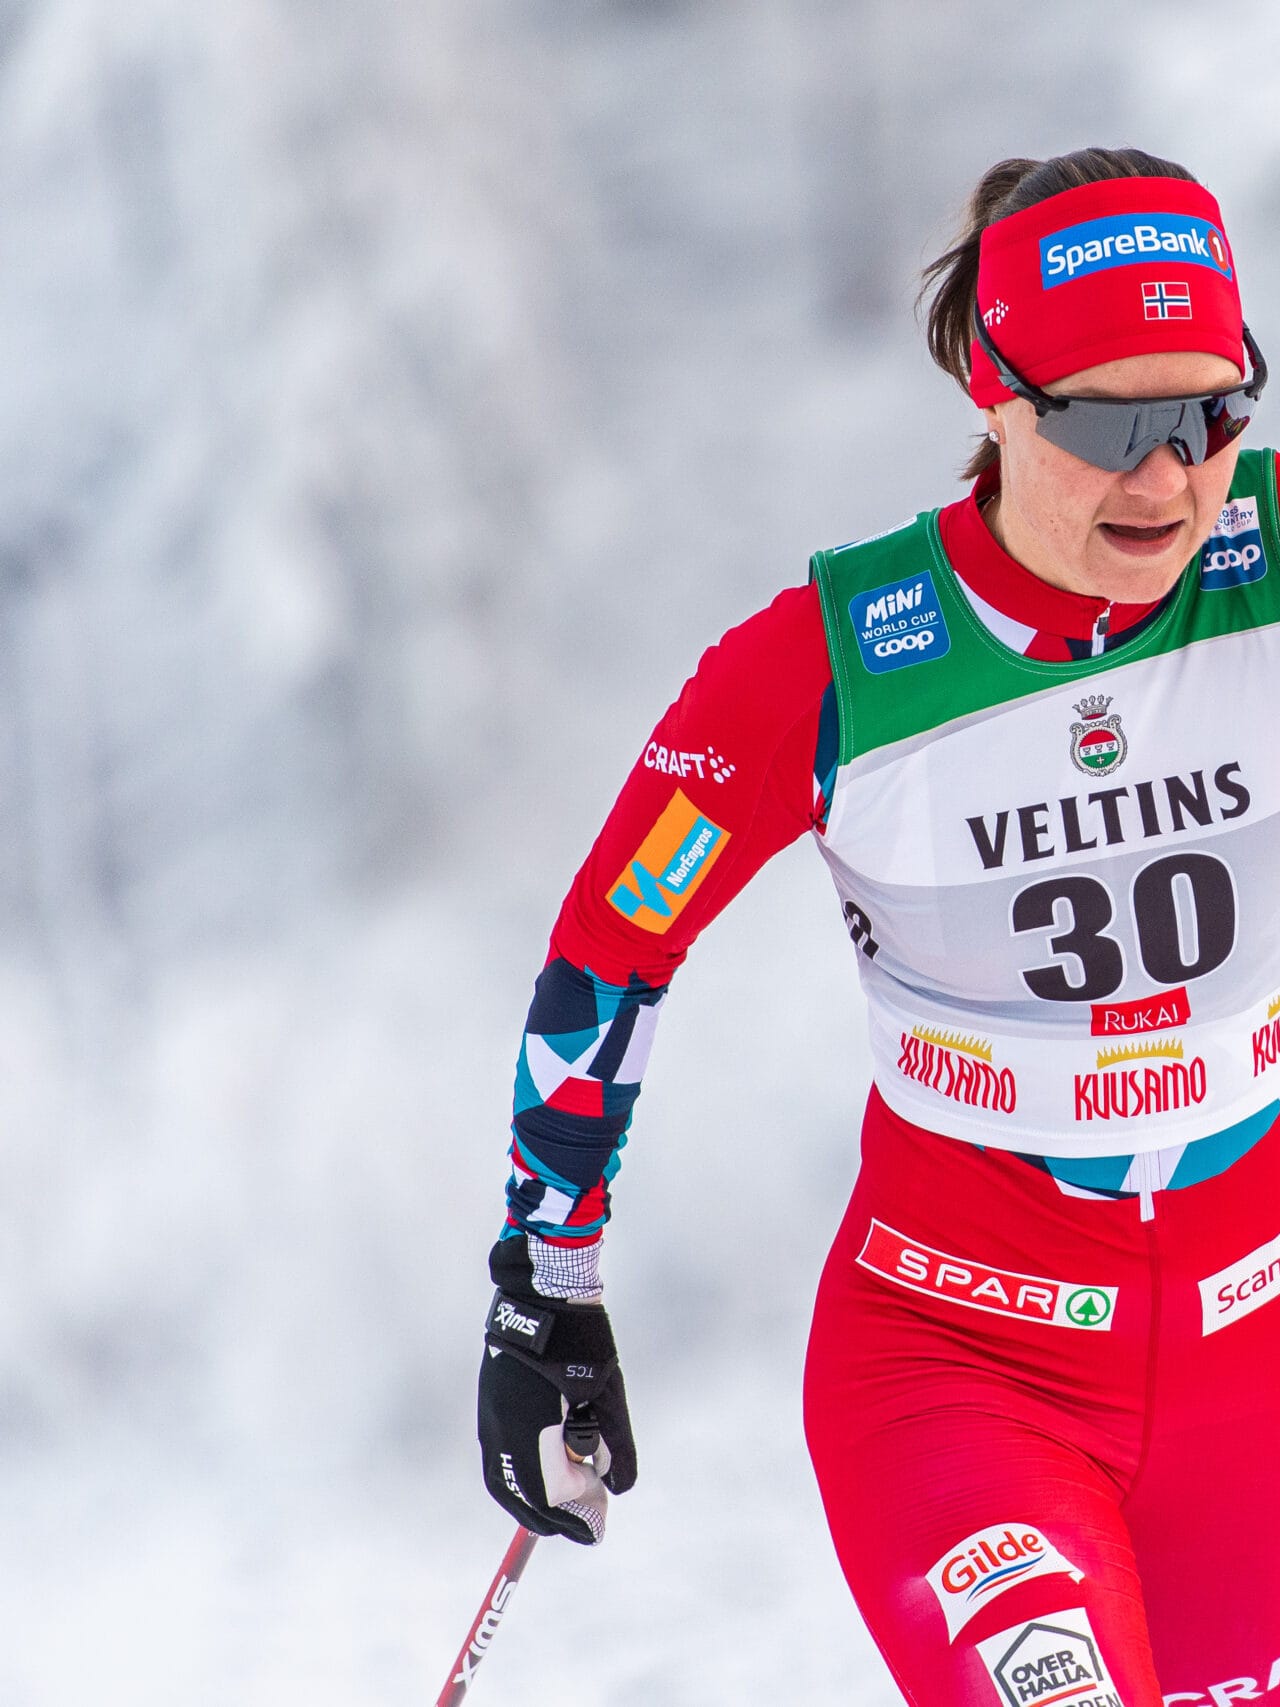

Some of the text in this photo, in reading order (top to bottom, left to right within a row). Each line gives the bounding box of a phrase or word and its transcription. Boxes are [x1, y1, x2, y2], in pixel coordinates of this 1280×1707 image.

[1048, 225, 1209, 276] SpareBank
[861, 611, 937, 640] WORLD CUP
[874, 630, 935, 658] coop
[644, 741, 705, 779] CRAFT
[965, 760, 1251, 870] VELTINS
[666, 827, 713, 888] NorEngros
[1012, 852, 1236, 1002] 30
[897, 1032, 1017, 1114] KUUSAMO
[1074, 1056, 1207, 1121] KUUSAMO
[896, 1248, 1054, 1314] SPAR
[566, 1365, 594, 1378] TCS
[500, 1453, 533, 1508] HEST
[941, 1531, 1044, 1594] Gilde
[1011, 1650, 1077, 1684] OVER
[1017, 1664, 1093, 1702] HALLA
